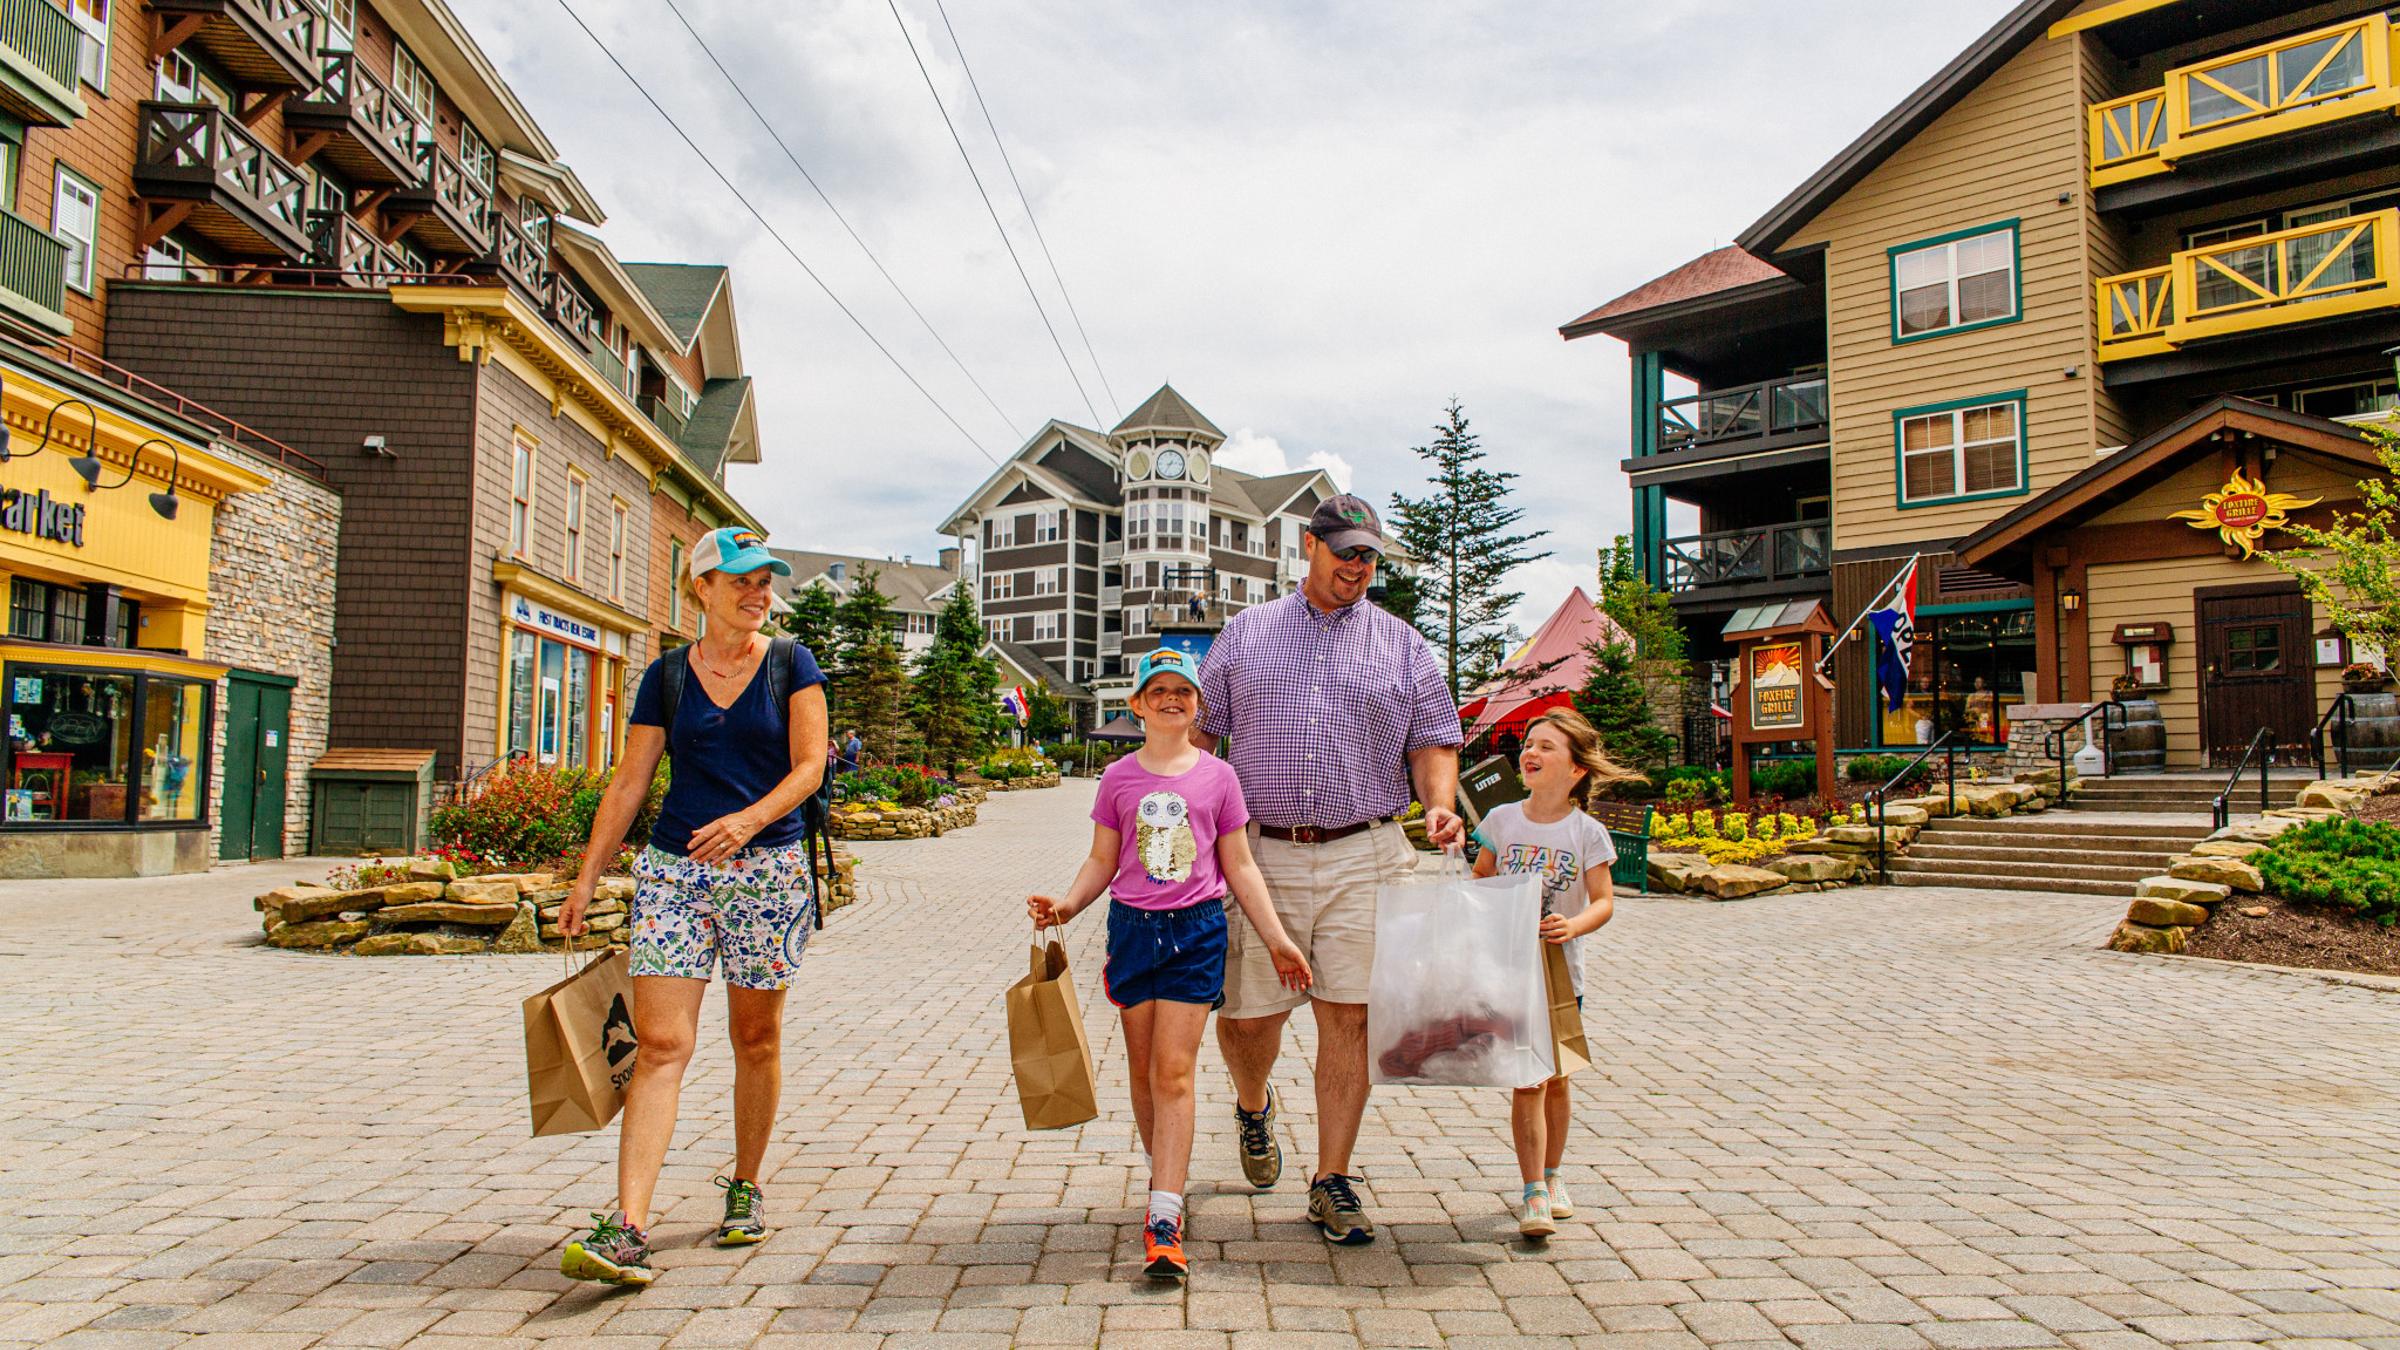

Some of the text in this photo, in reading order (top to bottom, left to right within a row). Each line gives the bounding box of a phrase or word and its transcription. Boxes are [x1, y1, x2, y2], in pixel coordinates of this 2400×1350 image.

[0, 484, 85, 548] arket
[2226, 506, 2258, 518] GRILLE
[1758, 688, 1797, 703] FOXFIRE
[1761, 701, 1794, 714] GRILLE
[1474, 772, 1502, 792] LITTER
[1500, 844, 1579, 881] STAR
